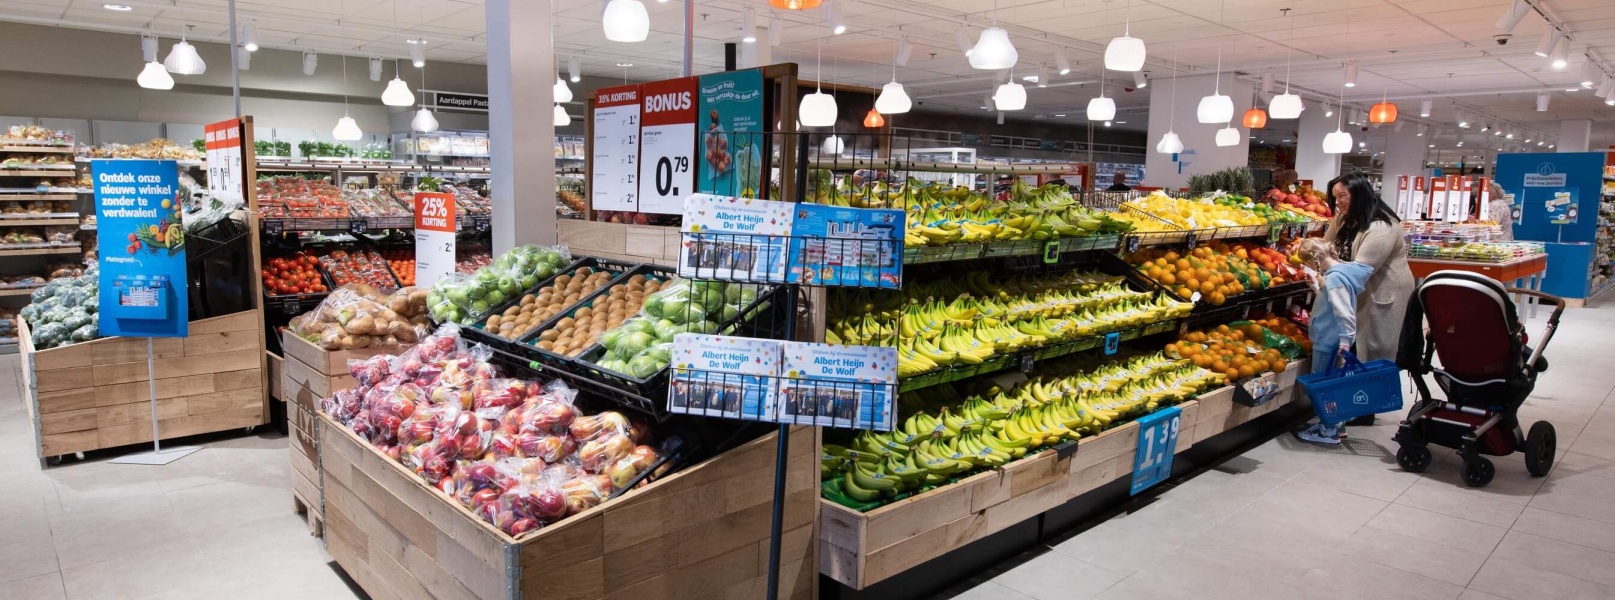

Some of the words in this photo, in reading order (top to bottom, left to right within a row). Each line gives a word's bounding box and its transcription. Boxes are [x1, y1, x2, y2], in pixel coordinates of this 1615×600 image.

[439, 96, 472, 106] Aardappel
[598, 94, 610, 103] 35%
[610, 91, 636, 102] KORTING
[645, 91, 692, 113] BONUS
[100, 172, 135, 183] Ontdek
[138, 175, 161, 183] onze
[656, 156, 688, 196] 0.79
[100, 184, 136, 194] nieuwe
[138, 185, 171, 194] winkel
[102, 196, 135, 206] zonder
[137, 197, 148, 206] te
[422, 197, 447, 217] 25%
[103, 208, 157, 218] verdwalen!
[716, 212, 741, 222] Albert
[743, 215, 764, 224] Heijn
[422, 217, 447, 228] KORTING
[737, 222, 755, 230] Wolf
[106, 256, 134, 264] Plattegrond
[702, 351, 727, 360] Albert
[729, 352, 749, 363] Heijn
[814, 357, 840, 366] Albert
[843, 359, 865, 368] Heijn
[722, 361, 740, 370] Wolf
[836, 367, 856, 376] Wolf
[1139, 416, 1180, 470] 1.39
